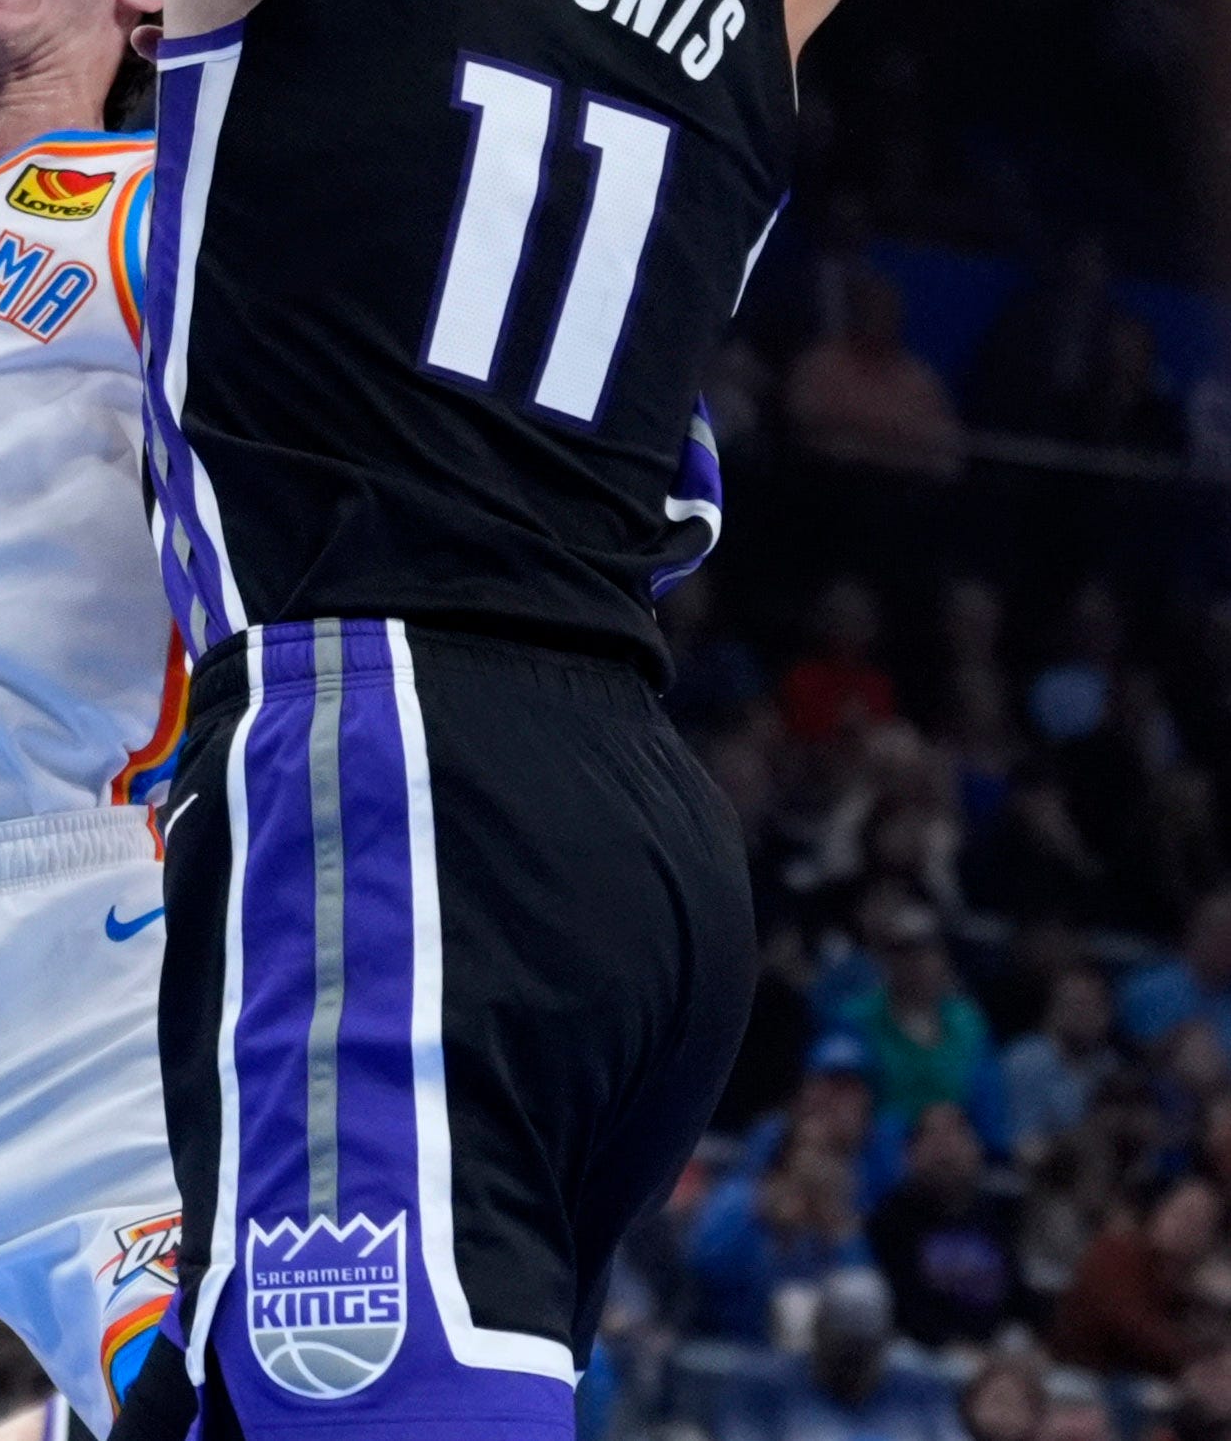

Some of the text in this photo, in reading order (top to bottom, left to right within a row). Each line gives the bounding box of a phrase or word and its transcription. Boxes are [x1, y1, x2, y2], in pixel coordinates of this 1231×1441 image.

[421, 53, 675, 428] 11
[256, 1265, 394, 1286] SACRAMENTO
[254, 1289, 400, 1329] KINGS
